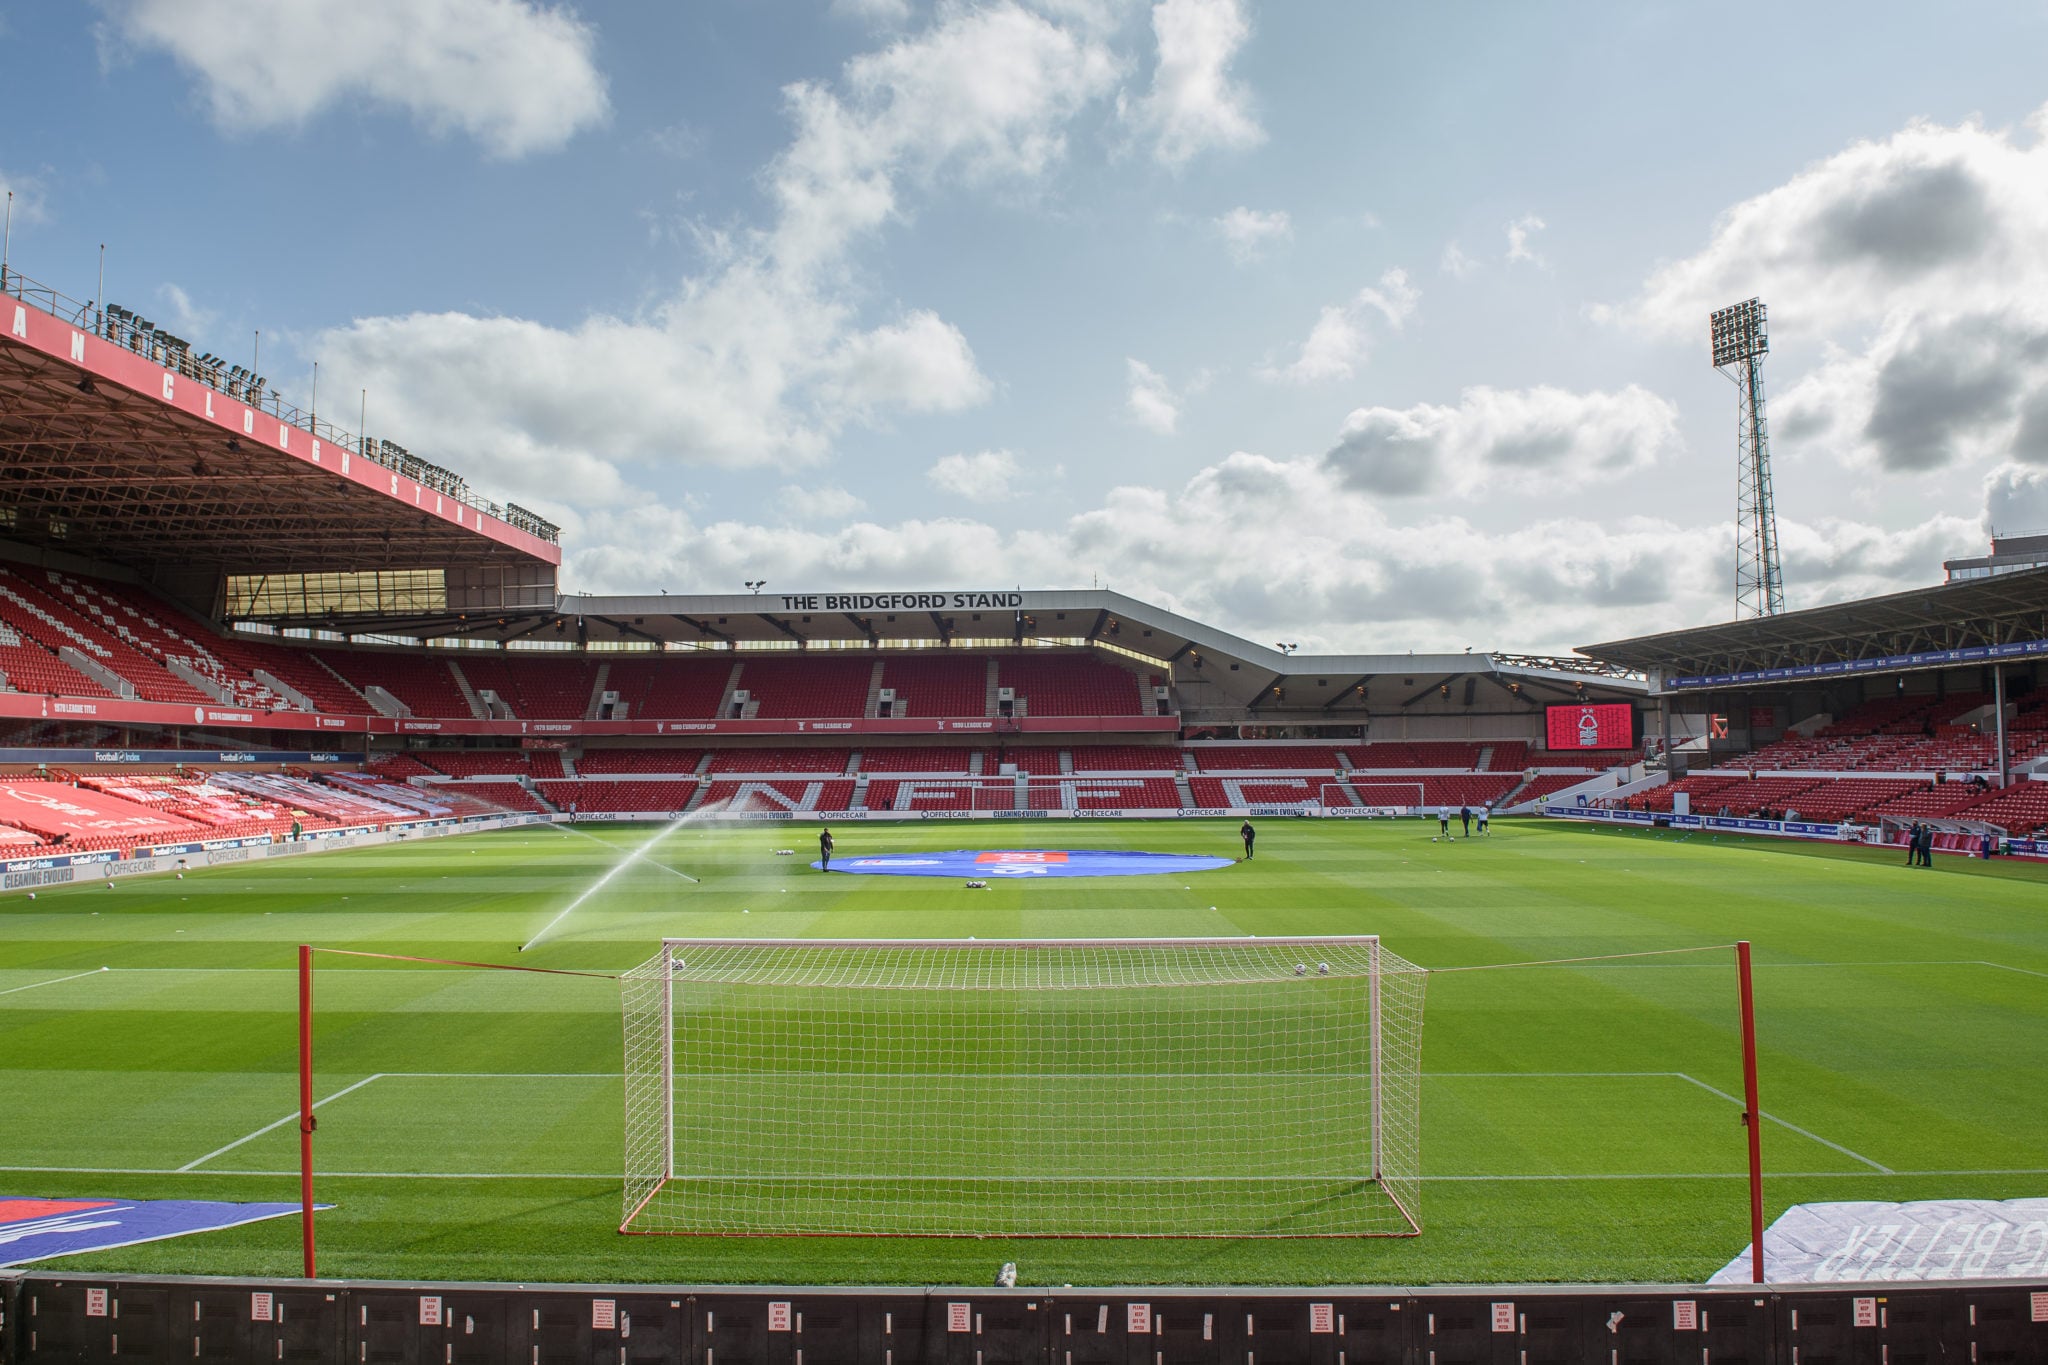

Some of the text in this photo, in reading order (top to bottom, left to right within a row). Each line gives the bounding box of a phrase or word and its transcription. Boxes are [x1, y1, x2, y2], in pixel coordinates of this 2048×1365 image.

[163, 373, 350, 474] CLOUGH
[391, 475, 482, 531] STAND
[781, 593, 1023, 610] THE BRIDGFORD STAND
[67, 704, 83, 713] LEAGUE
[84, 704, 96, 714] TITLE
[95, 752, 140, 761] Football Index
[220, 752, 256, 761] Football Index
[154, 848, 170, 856] Football
[215, 850, 249, 861] OFFICECARE
[8, 860, 54, 872] Football Index
[71, 854, 112, 866] Football Index
[114, 860, 156, 874] OFFICECARE
[5, 868, 74, 888] CLEANING EVOLVED
[1813, 1222, 2007, 1282] BETTER
